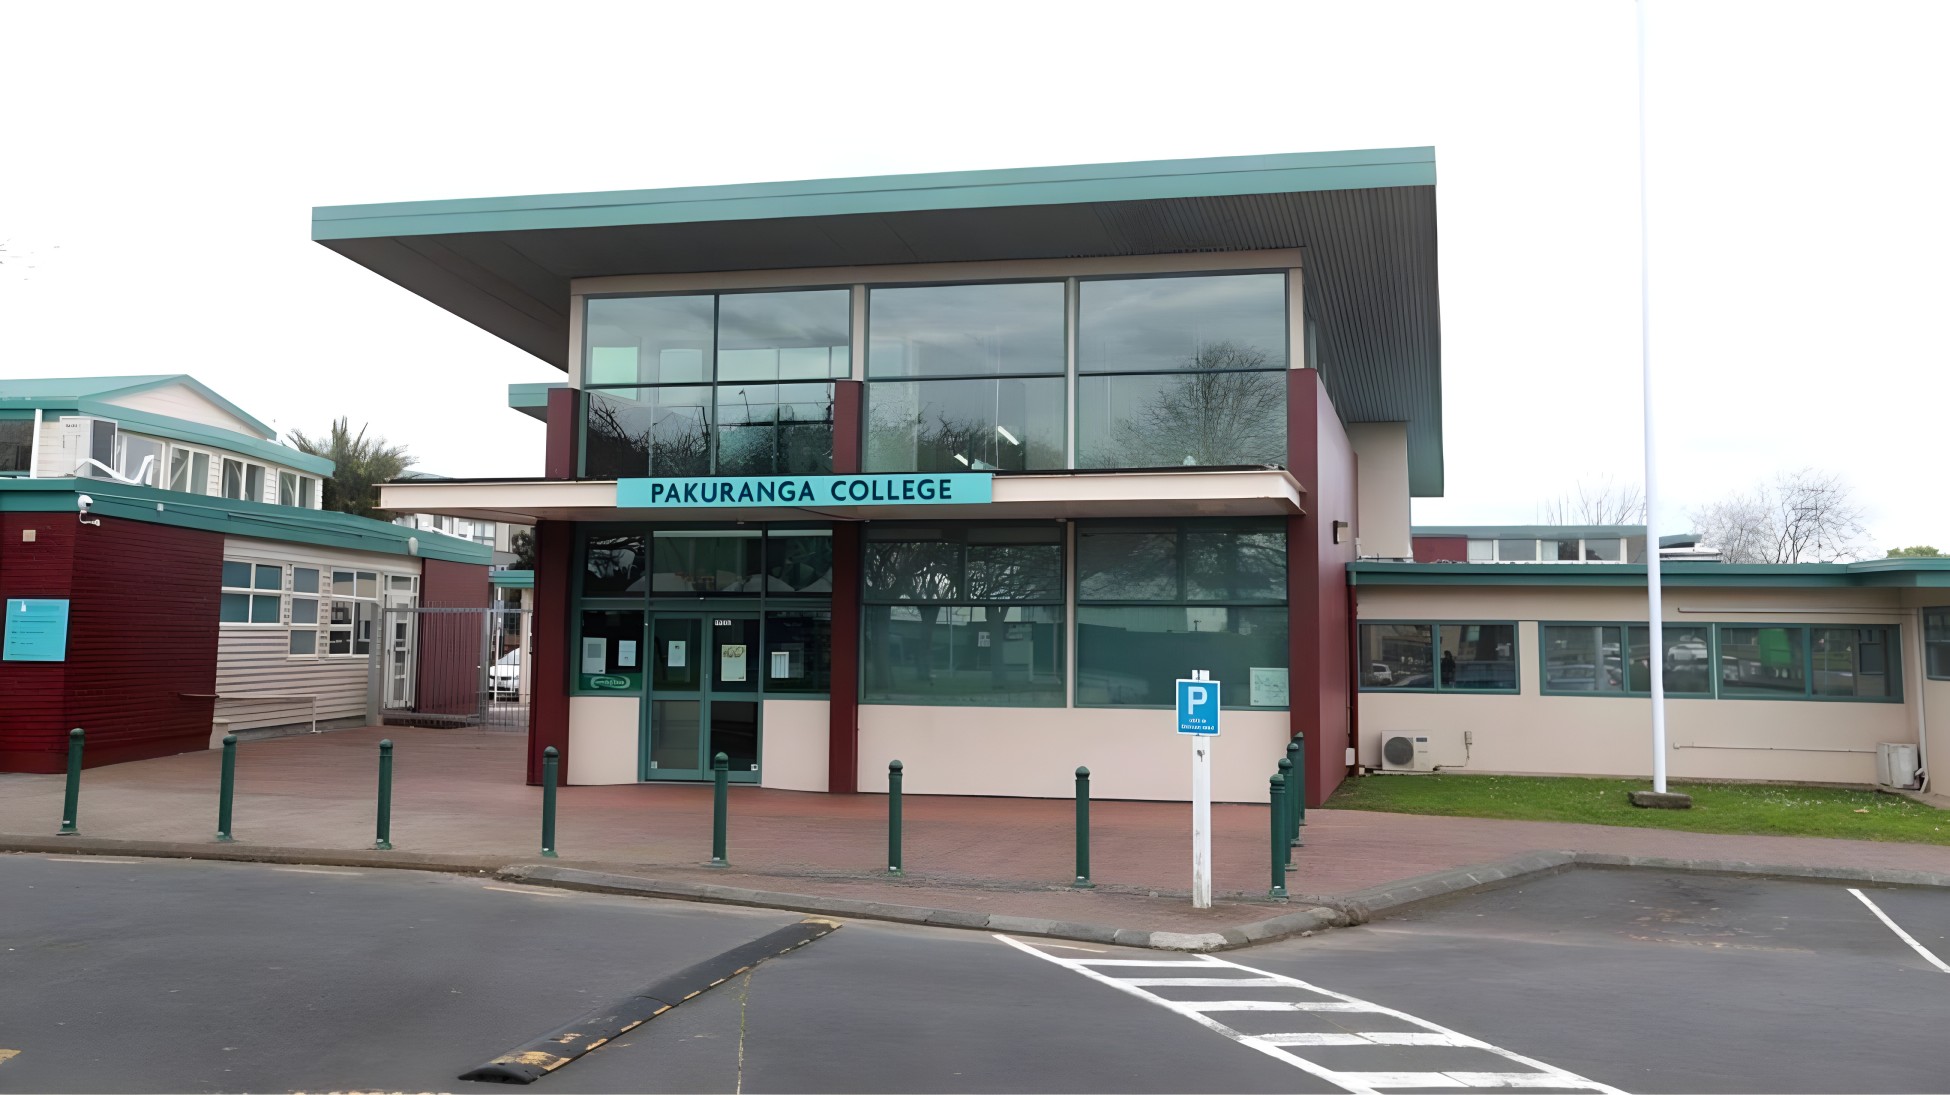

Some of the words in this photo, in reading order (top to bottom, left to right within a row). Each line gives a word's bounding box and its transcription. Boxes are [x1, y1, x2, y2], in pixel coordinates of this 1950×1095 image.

[651, 481, 815, 503] PAKURANGA
[830, 478, 952, 501] COLLEGE
[1188, 687, 1207, 714] P
